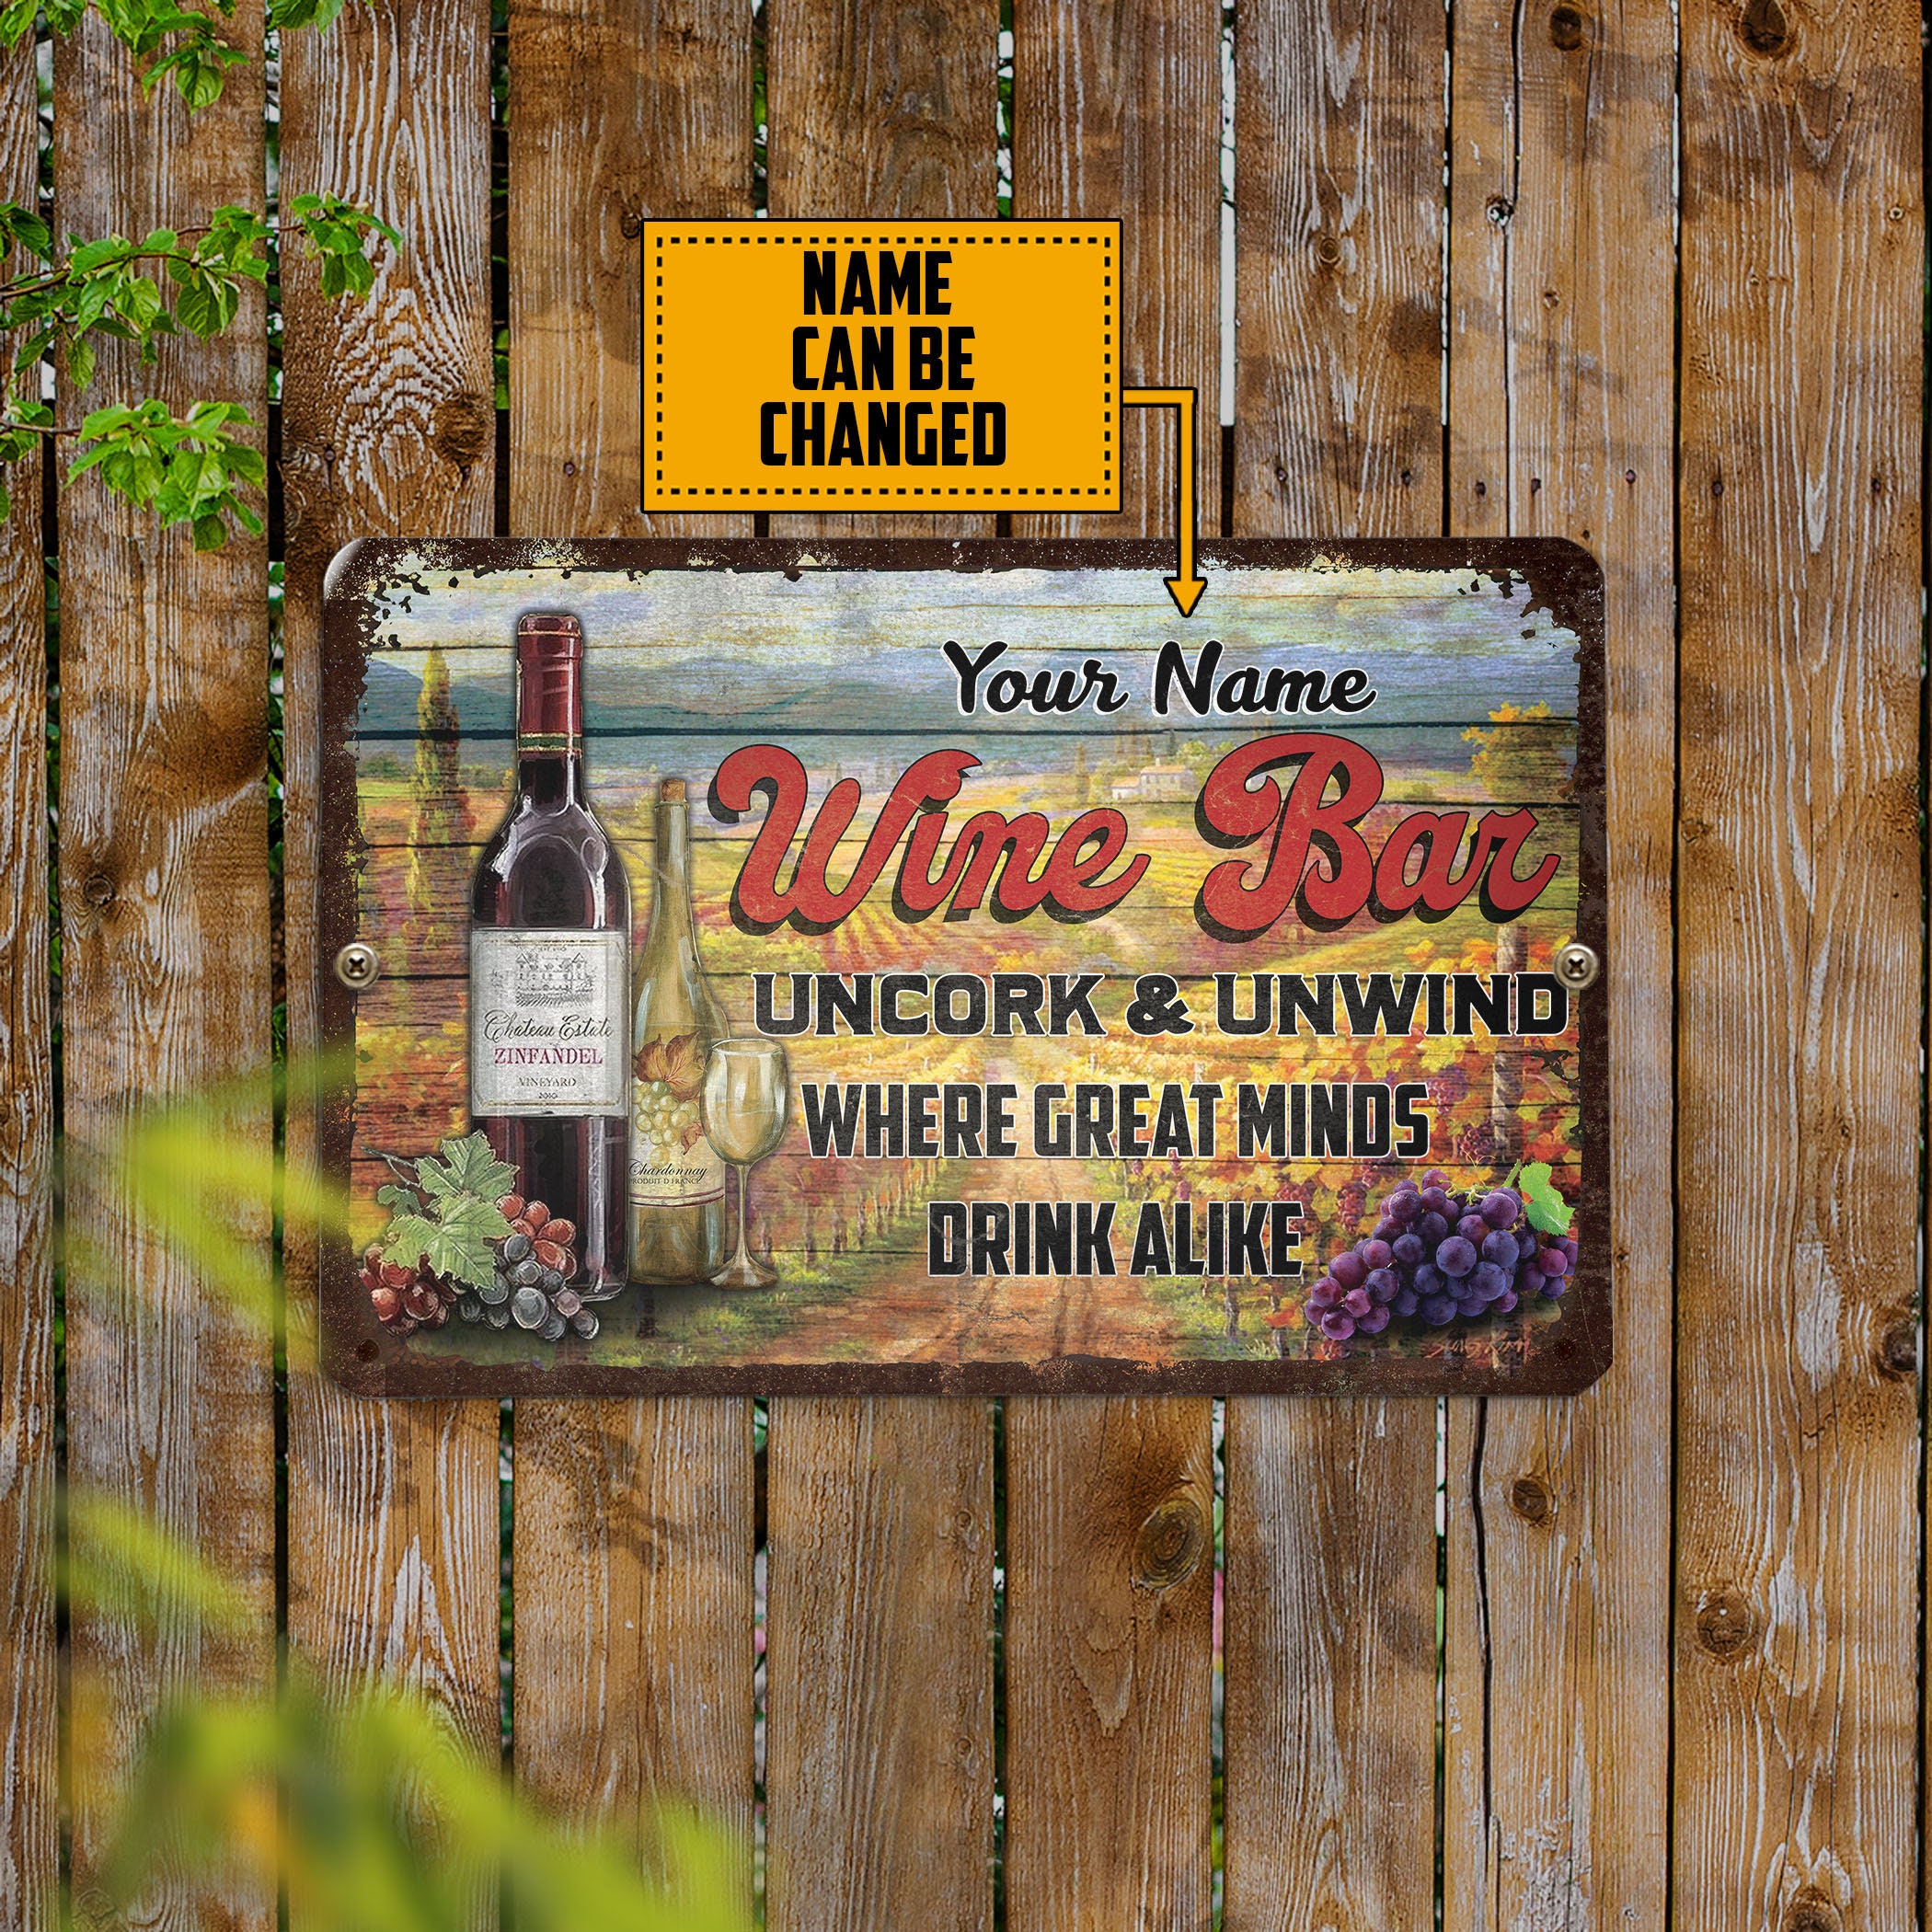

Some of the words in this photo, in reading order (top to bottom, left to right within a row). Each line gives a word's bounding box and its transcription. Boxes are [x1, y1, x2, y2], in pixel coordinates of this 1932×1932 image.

[941, 640, 1129, 716] Your
[1155, 639, 1377, 716] Name
[707, 743, 1151, 937] Wine
[1195, 732, 1562, 944] Bar
[751, 972, 1108, 1037] UNCORK
[1125, 973, 1195, 1037] &
[1214, 972, 1570, 1038] UNWIND
[494, 1047, 604, 1064] ZINFANDEL
[518, 1076, 578, 1087] VINEYARD
[800, 1082, 1019, 1158] WHERE
[1032, 1082, 1225, 1158] GREAT
[1236, 1082, 1429, 1158] MINDS
[628, 1158, 707, 1183] Chardonnay
[926, 1201, 1118, 1277] DRINK
[1128, 1201, 1304, 1277] ALIKE
